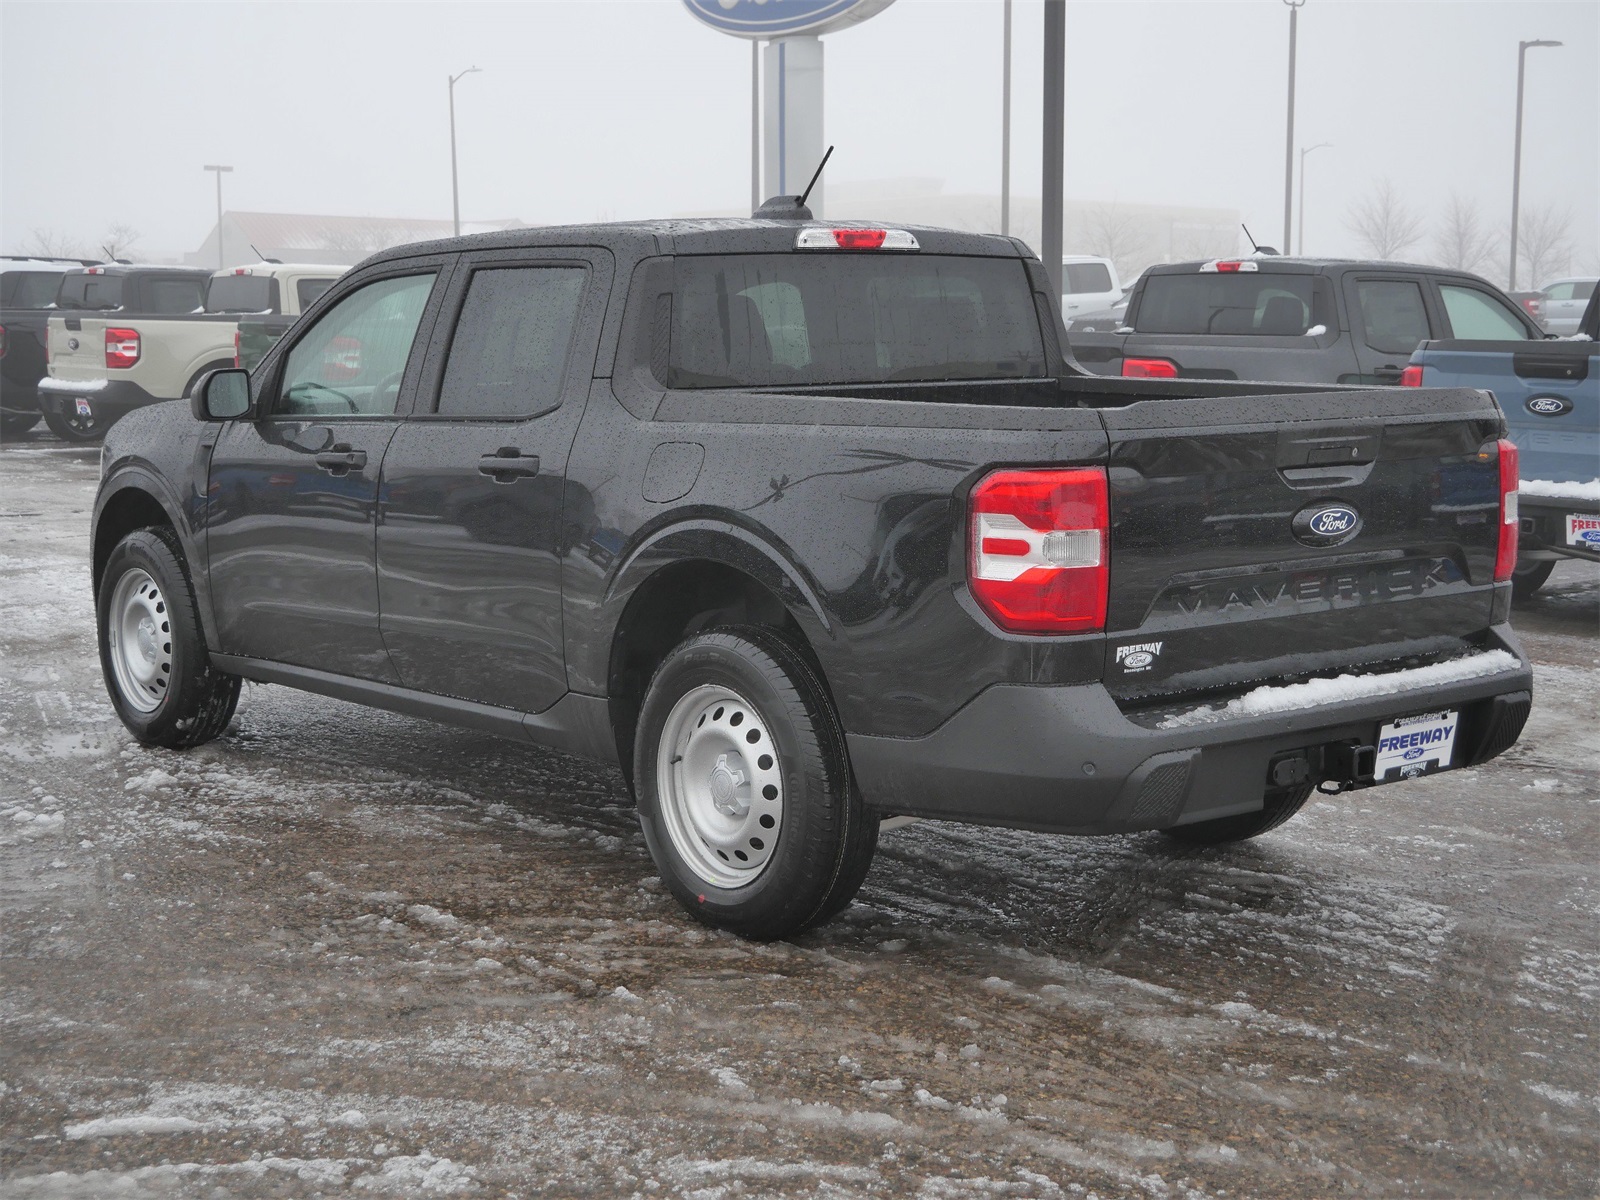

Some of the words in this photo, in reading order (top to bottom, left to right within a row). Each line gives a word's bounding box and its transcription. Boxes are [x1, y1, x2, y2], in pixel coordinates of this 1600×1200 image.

[1536, 400, 1557, 411] Ford
[1320, 512, 1348, 531] Ford
[1171, 562, 1445, 615] MAVERICK
[1116, 641, 1163, 664] FREEWAY
[1379, 725, 1454, 754] FREEWAY
[1407, 748, 1421, 759] Ford
[1400, 761, 1427, 777] FREEWAY
